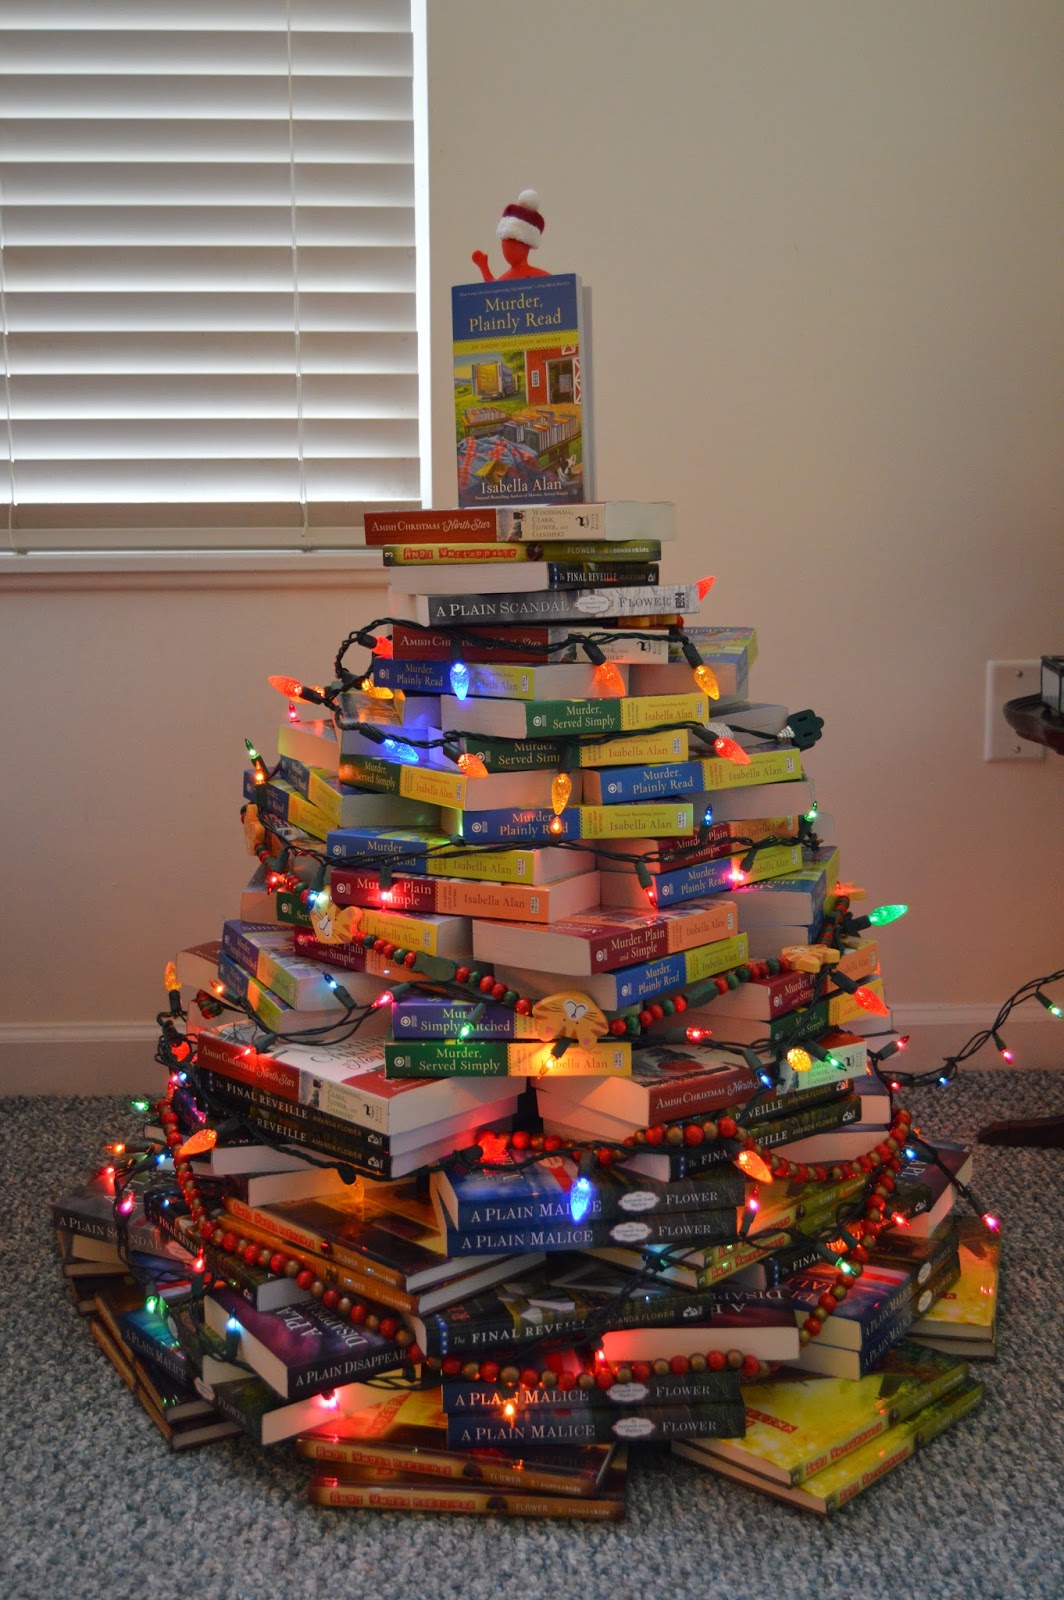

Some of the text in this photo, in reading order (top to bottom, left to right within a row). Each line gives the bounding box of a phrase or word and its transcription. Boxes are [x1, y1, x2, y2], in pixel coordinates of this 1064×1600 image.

[485, 293, 542, 312] Murder,
[469, 308, 561, 333] Plainly Read
[482, 477, 562, 493] Isabella Alan
[372, 519, 491, 532] AMISH CHRISTMAS North Star
[567, 573, 587, 581] FINAL
[589, 573, 617, 581] REVEILLE
[437, 607, 446, 617] A
[450, 603, 496, 616] PLAIN
[500, 600, 569, 615] SCANDAL
[620, 597, 671, 608] FLOWER
[401, 636, 430, 646] AMISH
[406, 664, 434, 675] Murder,
[397, 675, 443, 686] Plainly Read
[500, 680, 517, 690] Alan
[567, 705, 601, 715] Murder,
[645, 708, 693, 721] Isabella Alan
[553, 716, 583, 729] Served
[585, 715, 615, 728] Simply
[609, 748, 643, 757] Isabella
[645, 745, 668, 755] Alan
[499, 753, 533, 765] Served
[356, 772, 396, 790] Served Simply
[644, 769, 681, 781] Murder,
[729, 766, 782, 781] Isabella Alan
[416, 783, 453, 798] Isabella Alan
[633, 776, 693, 794] Plainly Read
[500, 824, 538, 837] Plainly
[611, 820, 672, 831] Isabella Alan
[709, 828, 728, 841] Plain
[454, 861, 485, 874] Isabella
[487, 864, 512, 874] Alan
[404, 881, 432, 895] Plain
[681, 876, 726, 895] Plainly Read
[464, 894, 499, 906] Isabella
[502, 895, 525, 909] Alan
[686, 920, 725, 936] Isabella Alan
[404, 933, 419, 945] Alan
[611, 927, 665, 951] Murder, Plain
[329, 949, 355, 965] Simple
[631, 944, 657, 959] Simple
[702, 952, 737, 971] Isabella Alan
[638, 973, 680, 995] Plainly Read
[421, 1021, 462, 1035] Simply
[436, 1048, 482, 1059] Murder,
[222, 1051, 256, 1073] CHRISTMAS
[279, 1071, 295, 1088] Star
[419, 1060, 500, 1074] Served Simply
[584, 1058, 608, 1069] Alan
[226, 1079, 258, 1102] FINAL
[260, 1094, 308, 1120] REVEILLE
[656, 1079, 754, 1110] AMISH CHRISTMAS North
[257, 1118, 307, 1143] REVEILLE
[313, 1115, 362, 1136] AMANDA FLOWER
[702, 1149, 730, 1165] FINA
[666, 1192, 718, 1205] FLOWER
[471, 1206, 534, 1223] A PLAIN
[59, 1217, 105, 1236] A PLAIN
[659, 1224, 711, 1236] FLOWER
[462, 1229, 593, 1248] A PLAIN MALICE
[642, 1309, 675, 1322] FLOWER
[454, 1327, 521, 1345] The FINAL
[156, 1352, 186, 1380] MALICE
[296, 1364, 342, 1387] A PLAIN
[455, 1389, 590, 1407] A PLAN MALICE
[656, 1385, 710, 1397] FLOWER
[461, 1423, 596, 1441] A PLAIN MALICE
[662, 1420, 717, 1433] FLOWER
